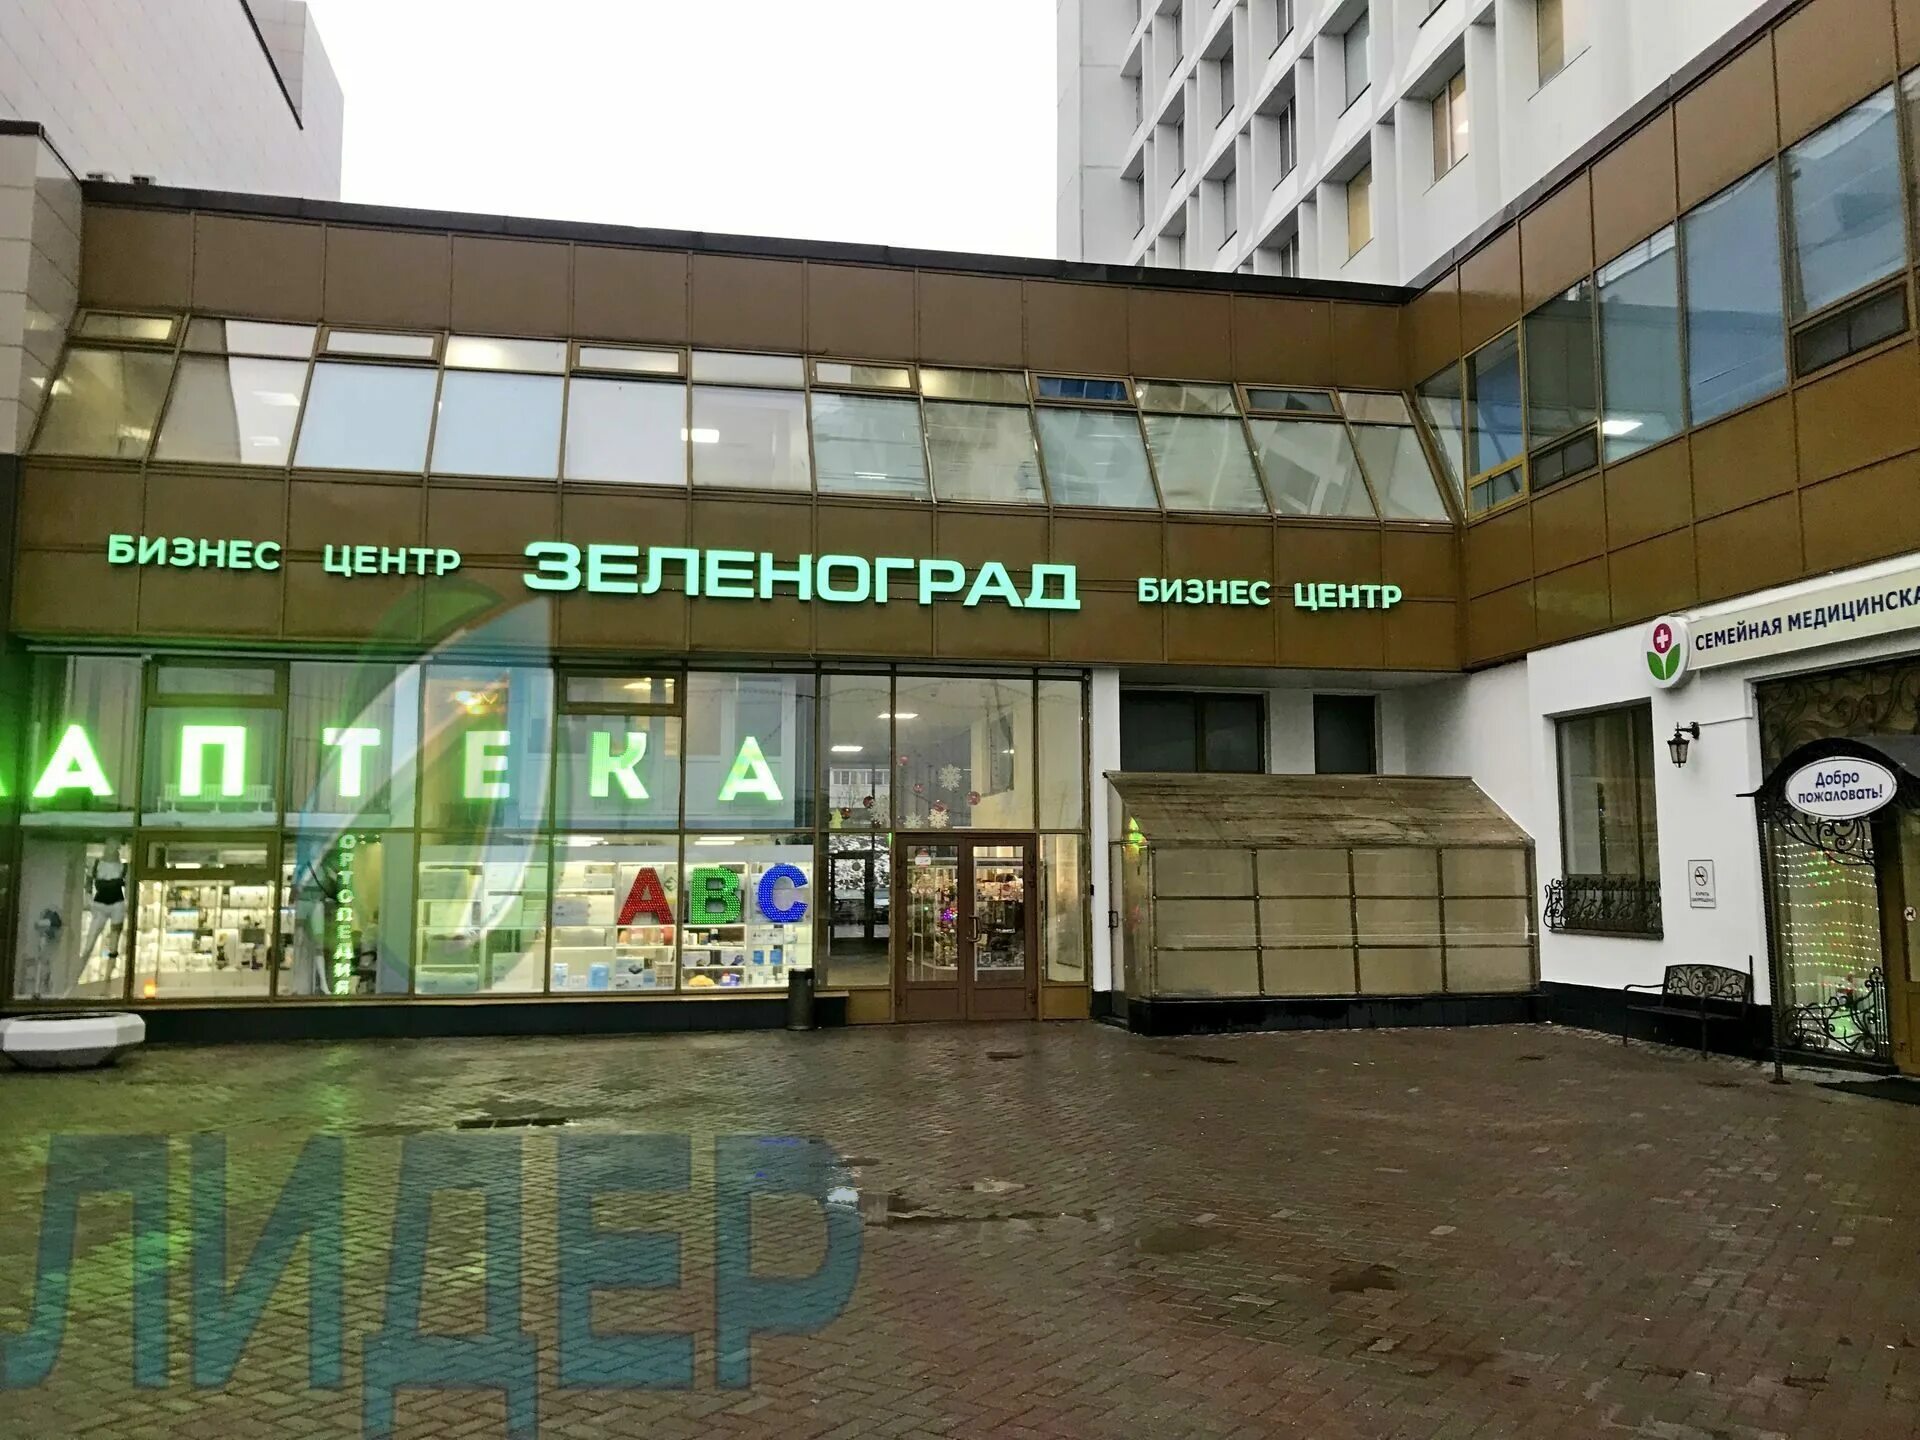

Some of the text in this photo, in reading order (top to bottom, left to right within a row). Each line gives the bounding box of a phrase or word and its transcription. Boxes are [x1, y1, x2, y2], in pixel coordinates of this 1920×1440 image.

[108, 534, 461, 577] БИЗНЕС ЦЕНТР
[523, 541, 1081, 610] ЗЕЛЕНОГРАД
[1138, 577, 1402, 611] БИЗНЕС ЦЕНТР
[1695, 617, 1782, 651] СЕМЕЙНАЯ
[32, 724, 784, 800] АПТЕКА
[1815, 770, 1860, 788] Добро
[1798, 784, 1883, 803] пожаловать!
[333, 834, 357, 995] ОРТОПЕДИЯ
